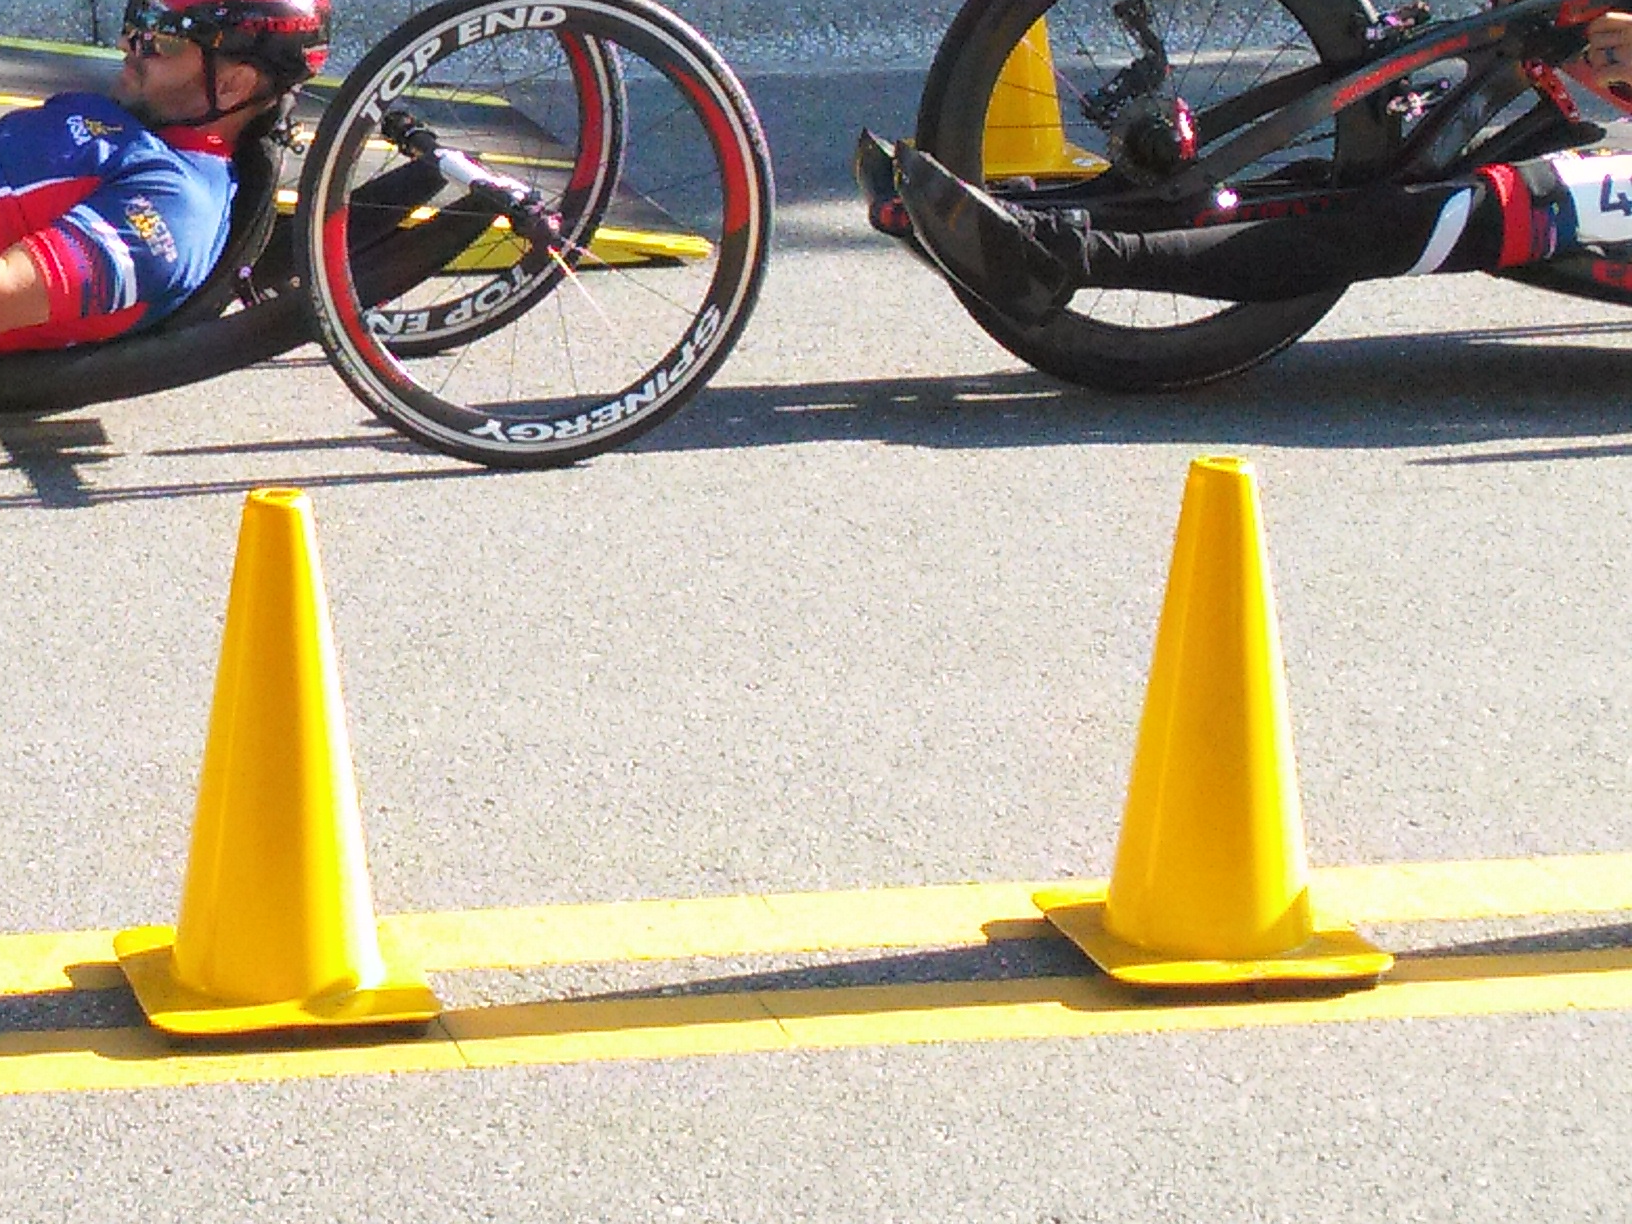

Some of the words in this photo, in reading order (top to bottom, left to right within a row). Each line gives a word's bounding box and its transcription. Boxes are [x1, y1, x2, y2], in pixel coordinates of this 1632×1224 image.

[359, 37, 442, 124] TOP
[457, 5, 567, 46] END
[367, 310, 430, 336] EN
[444, 265, 533, 326] TOP
[467, 302, 720, 443] SPINERGY
